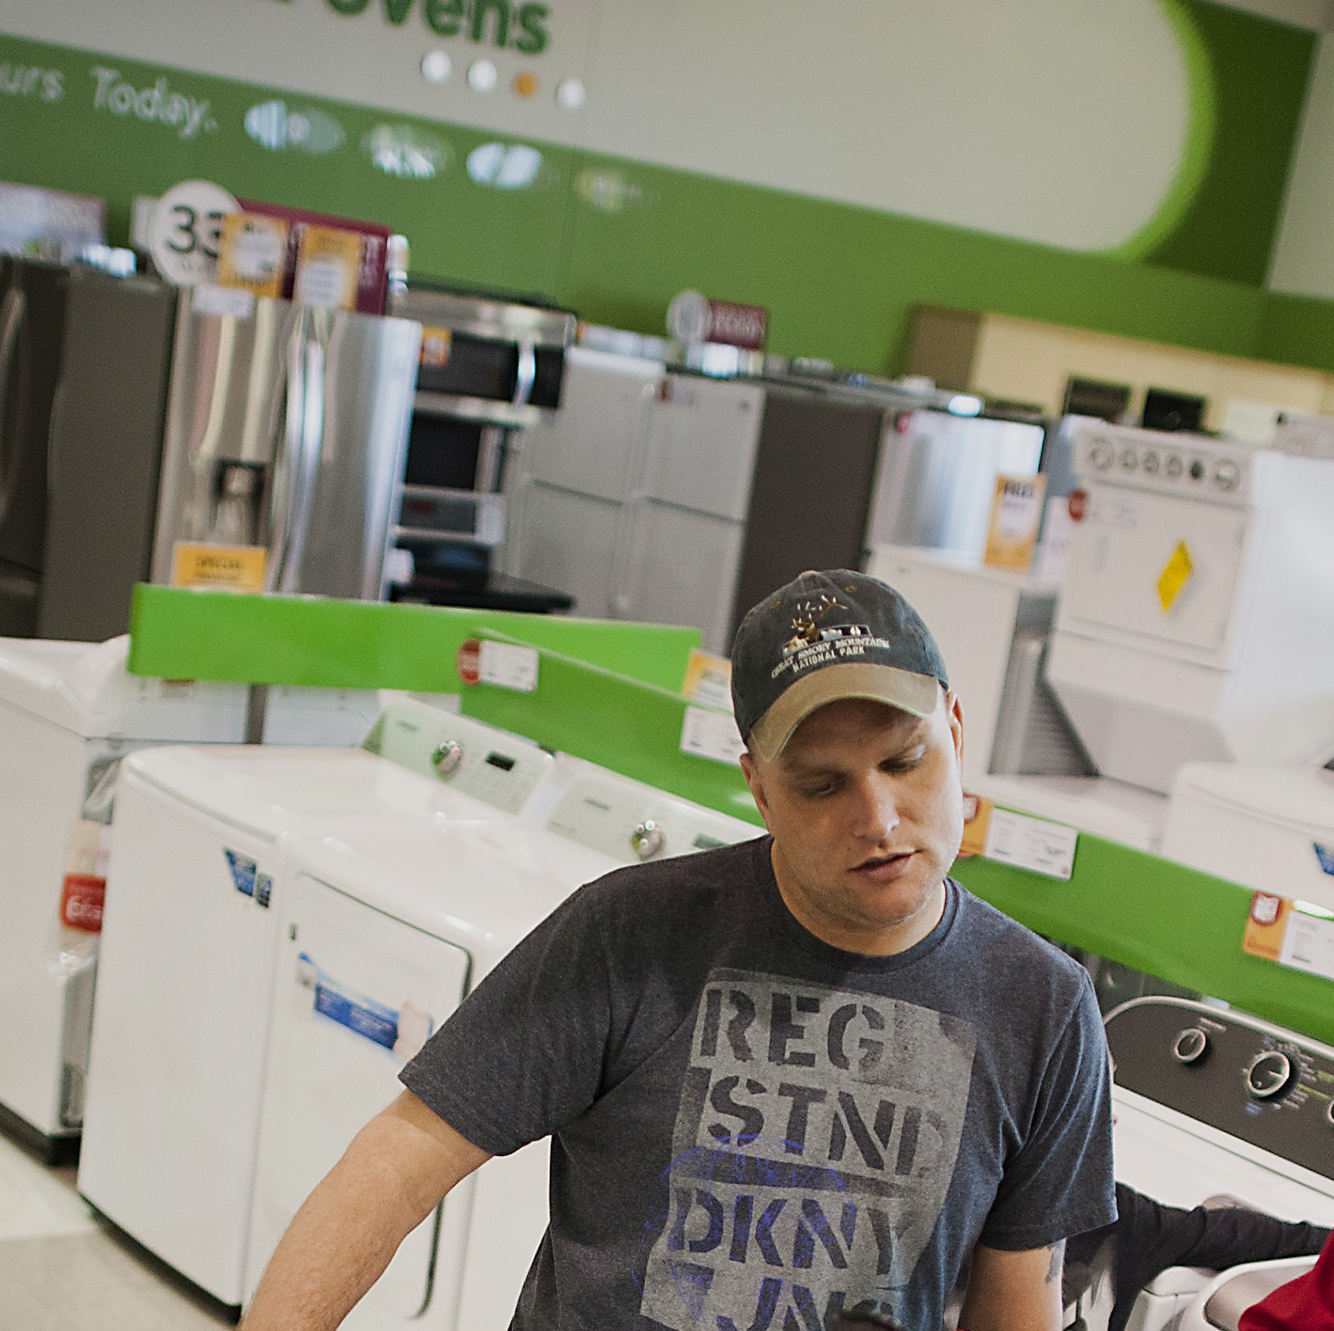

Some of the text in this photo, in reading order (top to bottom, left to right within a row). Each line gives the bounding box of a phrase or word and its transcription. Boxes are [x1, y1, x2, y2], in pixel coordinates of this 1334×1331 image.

[89, 66, 218, 138] Today.
[792, 646, 866, 673] NATIONAL PARK
[798, 642, 832, 660] SMOKY
[835, 637, 890, 648] MOUNTAINS
[700, 988, 885, 1071] REG
[667, 1185, 914, 1276] DKNY
